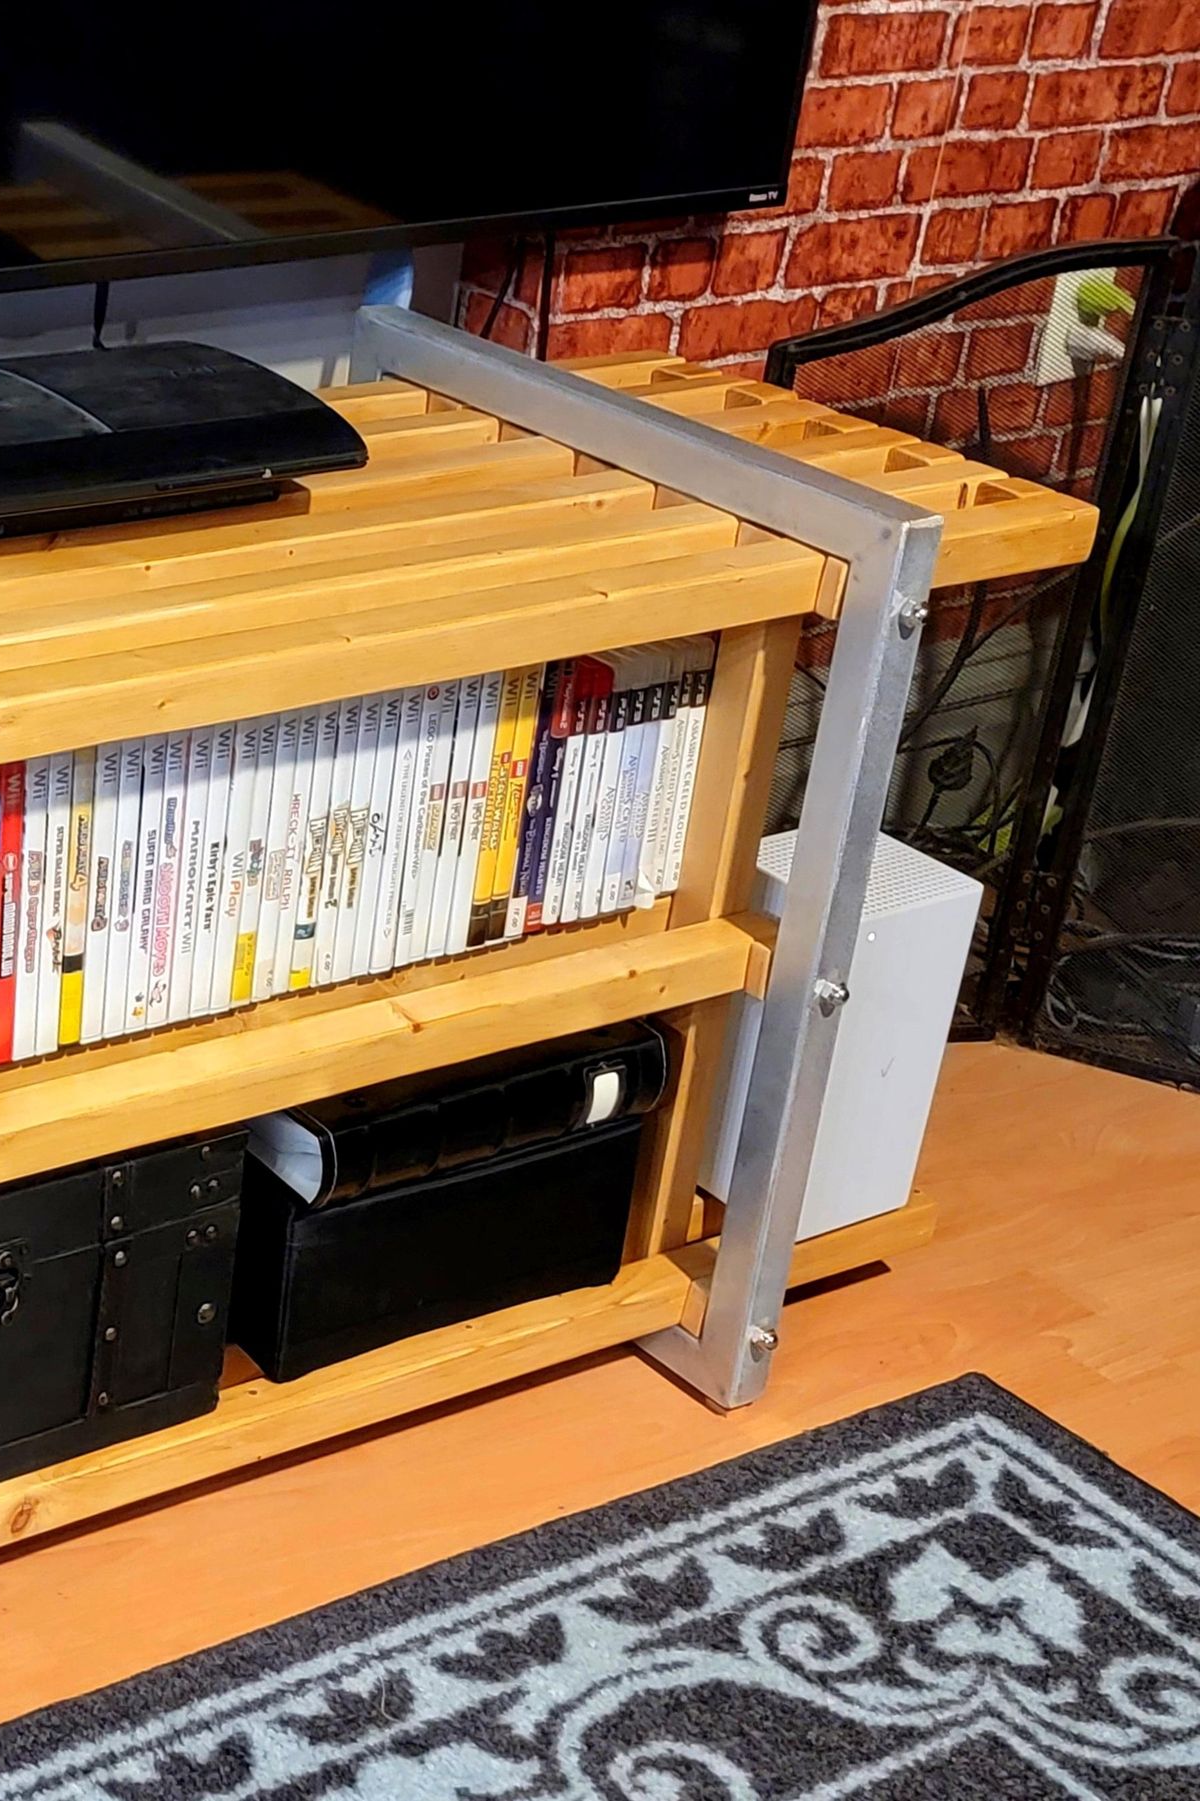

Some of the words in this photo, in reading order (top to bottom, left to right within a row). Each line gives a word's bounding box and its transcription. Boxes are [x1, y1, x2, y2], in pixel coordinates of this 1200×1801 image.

[768, 190, 779, 200] TV
[441, 686, 455, 713] Wii
[464, 681, 478, 709] Wii
[484, 681, 499, 708] Wii
[505, 678, 519, 706] Wii
[524, 672, 538, 699] Wii
[545, 671, 558, 698] Wii
[680, 674, 692, 705] PS3
[694, 674, 706, 705] PS3
[385, 700, 398, 728] Wii
[405, 694, 422, 723] Wii
[595, 699, 608, 730] PS3
[614, 698, 628, 729] PS3
[632, 691, 645, 723] PS3
[650, 688, 662, 719] PS3
[667, 685, 679, 717] PS3
[301, 716, 315, 745] Wii
[322, 712, 337, 740] Wii
[344, 707, 358, 734] Wii
[363, 704, 378, 732] Wii
[426, 714, 437, 742] LEGO
[574, 701, 587, 732] PS3
[216, 729, 231, 759] Wii
[241, 730, 256, 759] Wii
[260, 726, 274, 755] Wii
[281, 719, 297, 748] Wii
[103, 754, 116, 783] Wii
[125, 749, 139, 778] Wii
[150, 746, 164, 774] Wii
[167, 741, 182, 772] Wii
[194, 739, 209, 769] Wii
[421, 746, 433, 777] Pirates
[6, 773, 21, 804] Wii
[33, 768, 46, 799] Wii
[54, 766, 69, 796] Wii
[420, 780, 428, 789] of
[667, 760, 678, 790] CREED
[419, 791, 427, 805] the
[664, 791, 675, 805] IV
[678, 771, 692, 810] CREED
[650, 793, 661, 826] CREED
[55, 826, 64, 855] SUPER
[285, 793, 301, 861] WRECK-IT
[328, 808, 349, 854] RAYMAN
[345, 809, 369, 865] RAYMAN
[489, 808, 503, 850] WARS
[539, 817, 553, 859] KINGDOM
[557, 822, 571, 859] KINGDOM
[579, 814, 592, 851] KINGDOM
[646, 828, 657, 843] III
[672, 814, 686, 853] ROGUE
[145, 830, 156, 866] SUPER
[205, 842, 219, 878] Kirby's
[304, 817, 328, 874] RAYMAN
[53, 857, 62, 888] SMASH
[230, 852, 244, 878] Wii
[534, 861, 546, 894] HEARTS
[70, 874, 87, 891] 4
[142, 869, 153, 905] MARIO
[155, 862, 174, 926] SMOOTH
[204, 880, 216, 903] Epic
[279, 869, 293, 910] RALPH
[223, 879, 241, 918] Play
[324, 898, 337, 909] 2
[139, 908, 150, 950] GALAXY
[202, 906, 214, 929] Yarn
[150, 926, 169, 977] MOVES
[180, 933, 191, 954] Wii
